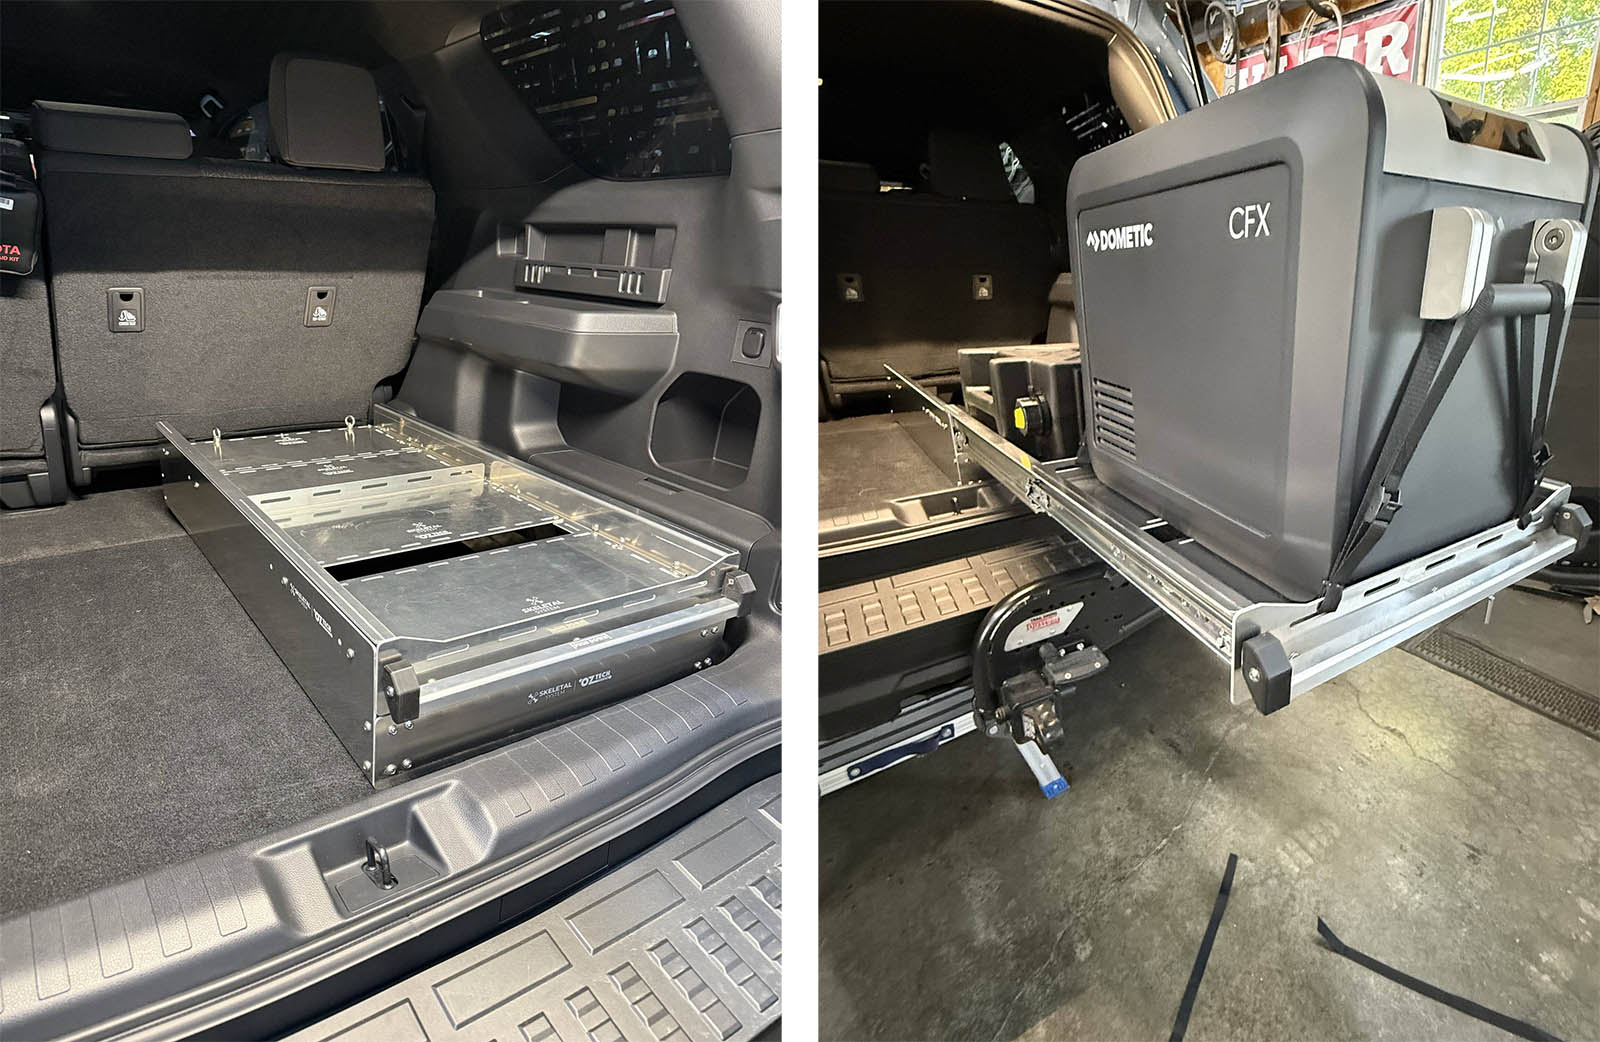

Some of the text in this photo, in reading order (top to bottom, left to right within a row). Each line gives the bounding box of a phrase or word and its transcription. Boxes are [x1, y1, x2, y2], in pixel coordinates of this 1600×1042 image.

[1228, 202, 1271, 240] CFX
[1100, 222, 1154, 251] DOMETIC
[539, 682, 572, 697] SKELETAL
